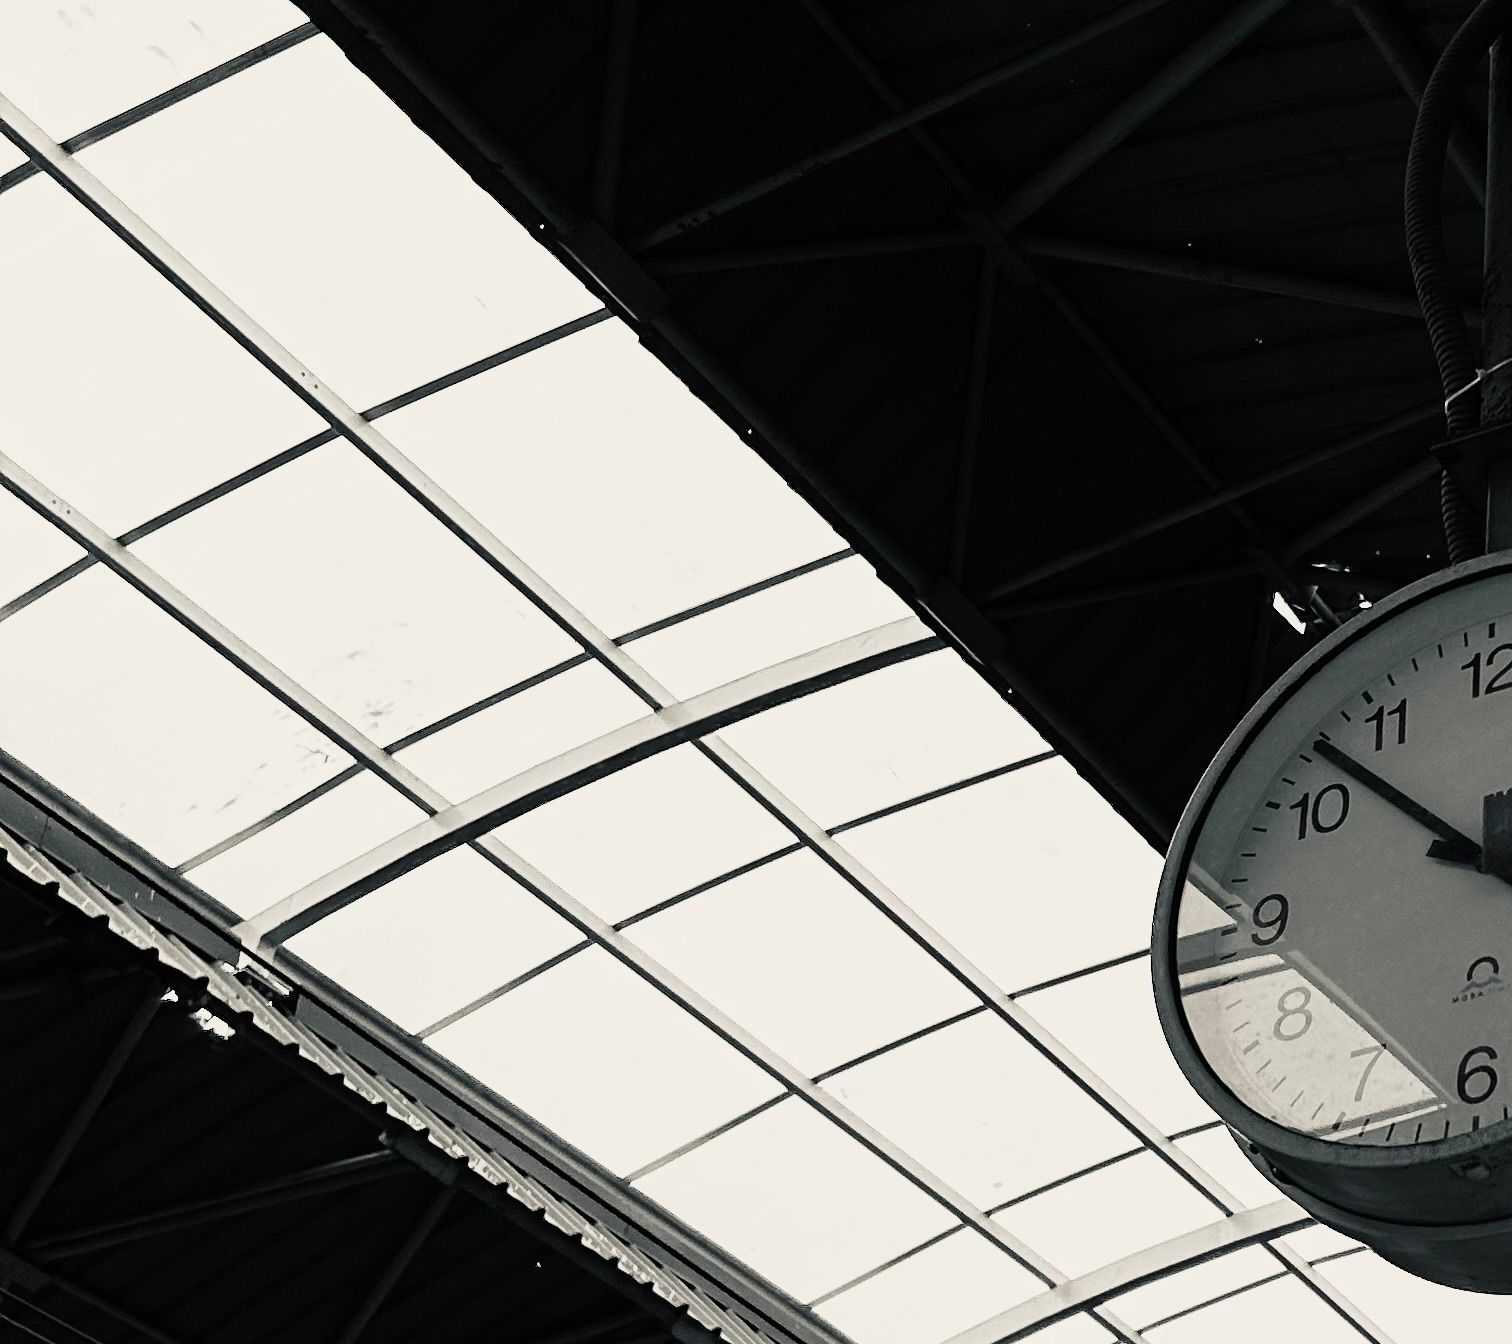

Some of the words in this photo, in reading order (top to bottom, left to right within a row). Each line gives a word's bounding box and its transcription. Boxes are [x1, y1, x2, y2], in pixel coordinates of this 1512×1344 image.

[1365, 698, 1407, 751] 11
[1289, 783, 1350, 840] 10
[1251, 893, 1290, 946] 9
[1273, 987, 1313, 1041] 8
[1350, 1044, 1387, 1102] 7
[1456, 1045, 1499, 1104] 6
